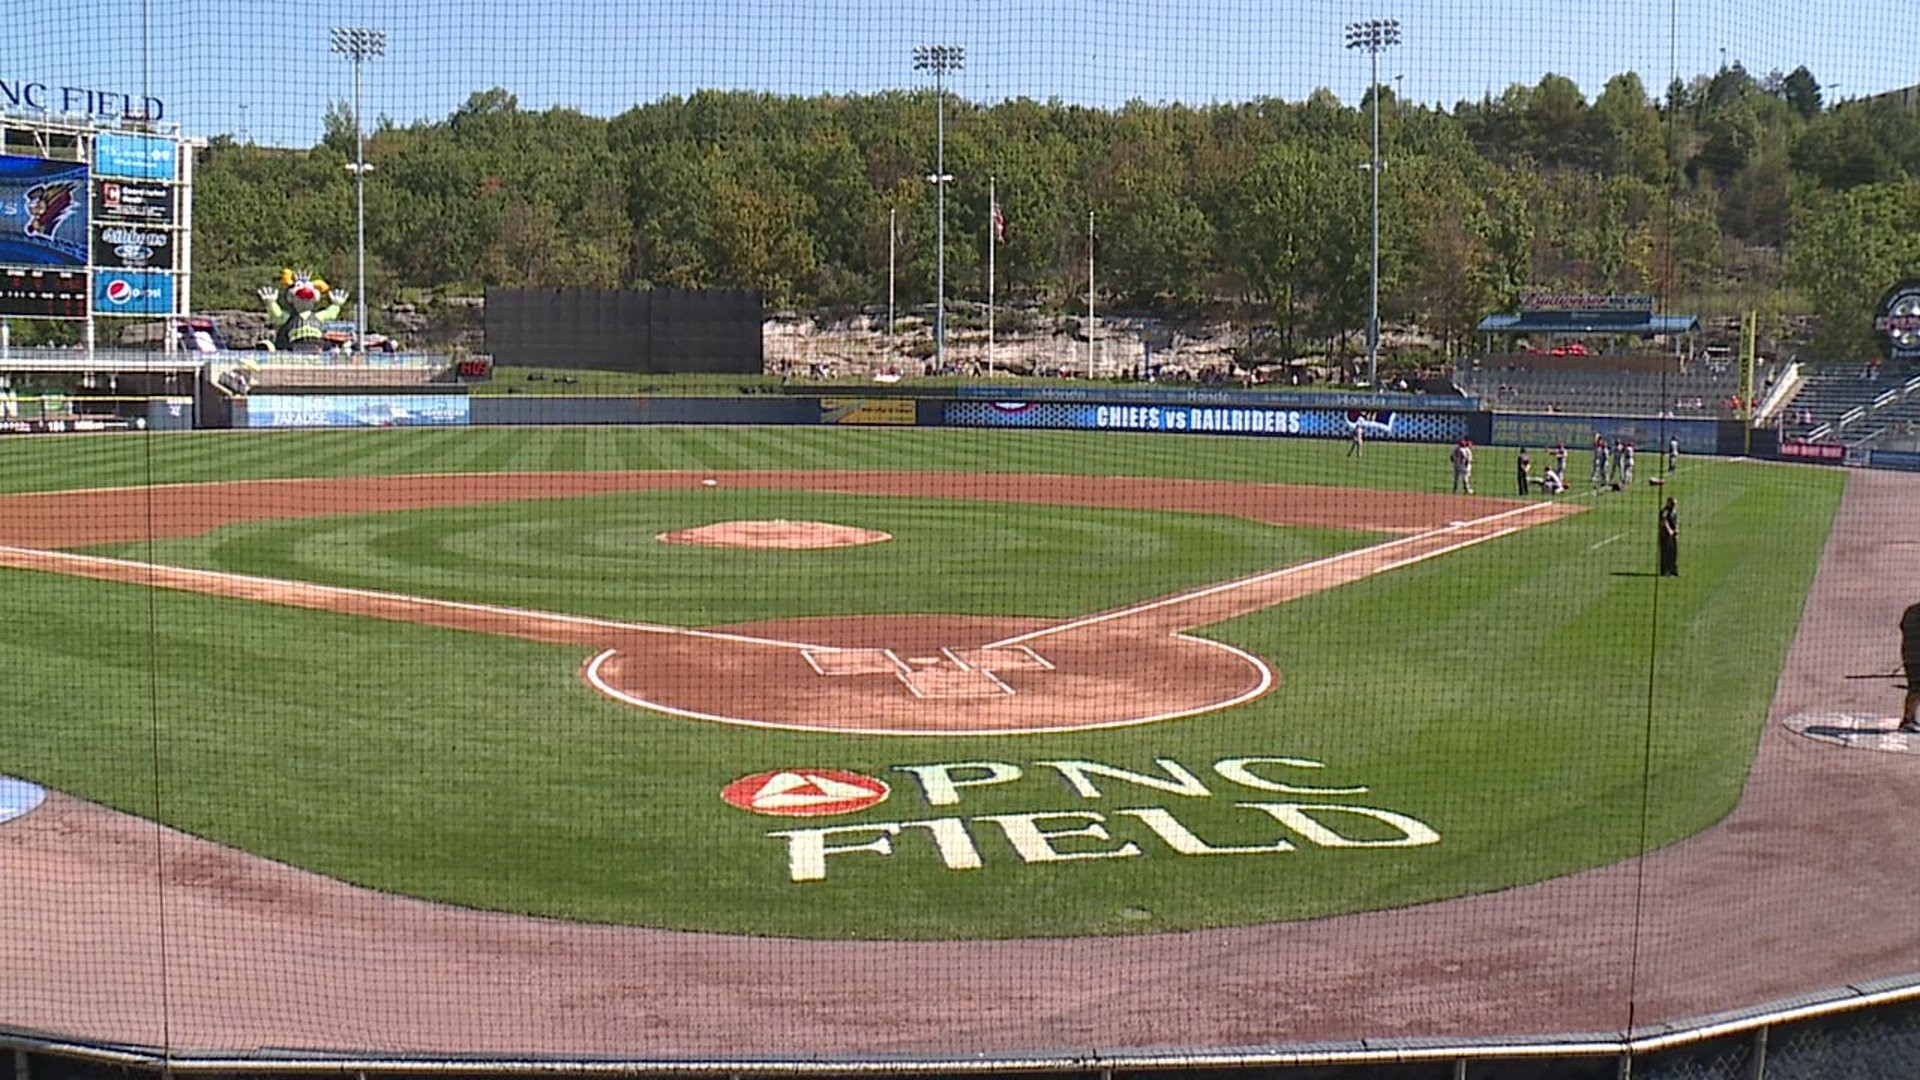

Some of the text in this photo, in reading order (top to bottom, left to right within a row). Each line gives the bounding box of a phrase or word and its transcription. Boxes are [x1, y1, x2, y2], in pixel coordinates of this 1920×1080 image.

[60, 86, 164, 121] FIELD
[1097, 405, 1159, 428] CHIEFS
[1191, 407, 1300, 432] RAILRIDERS
[893, 757, 1369, 806] PNC
[766, 803, 1441, 882] FIELD
